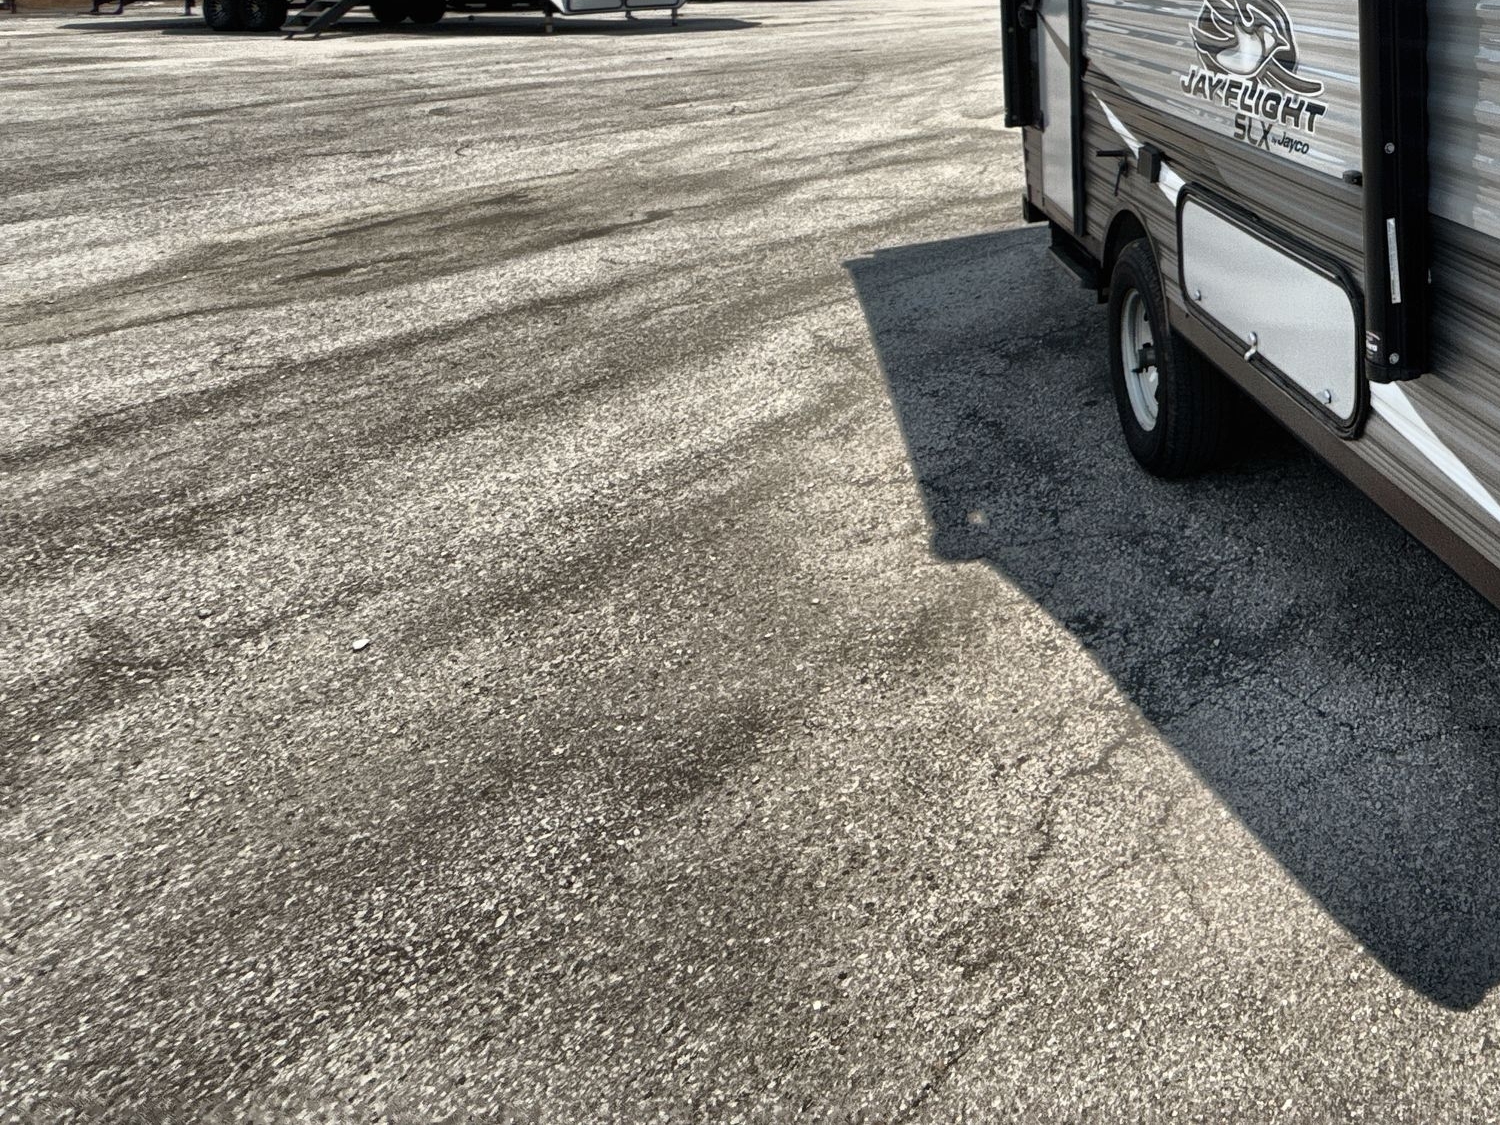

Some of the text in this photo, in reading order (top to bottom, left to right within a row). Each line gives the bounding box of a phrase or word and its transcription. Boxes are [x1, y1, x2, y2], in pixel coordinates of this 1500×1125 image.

[1224, 78, 1327, 133] FLIGHT
[1233, 113, 1273, 151] SLX
[1277, 131, 1310, 154] Jayco
